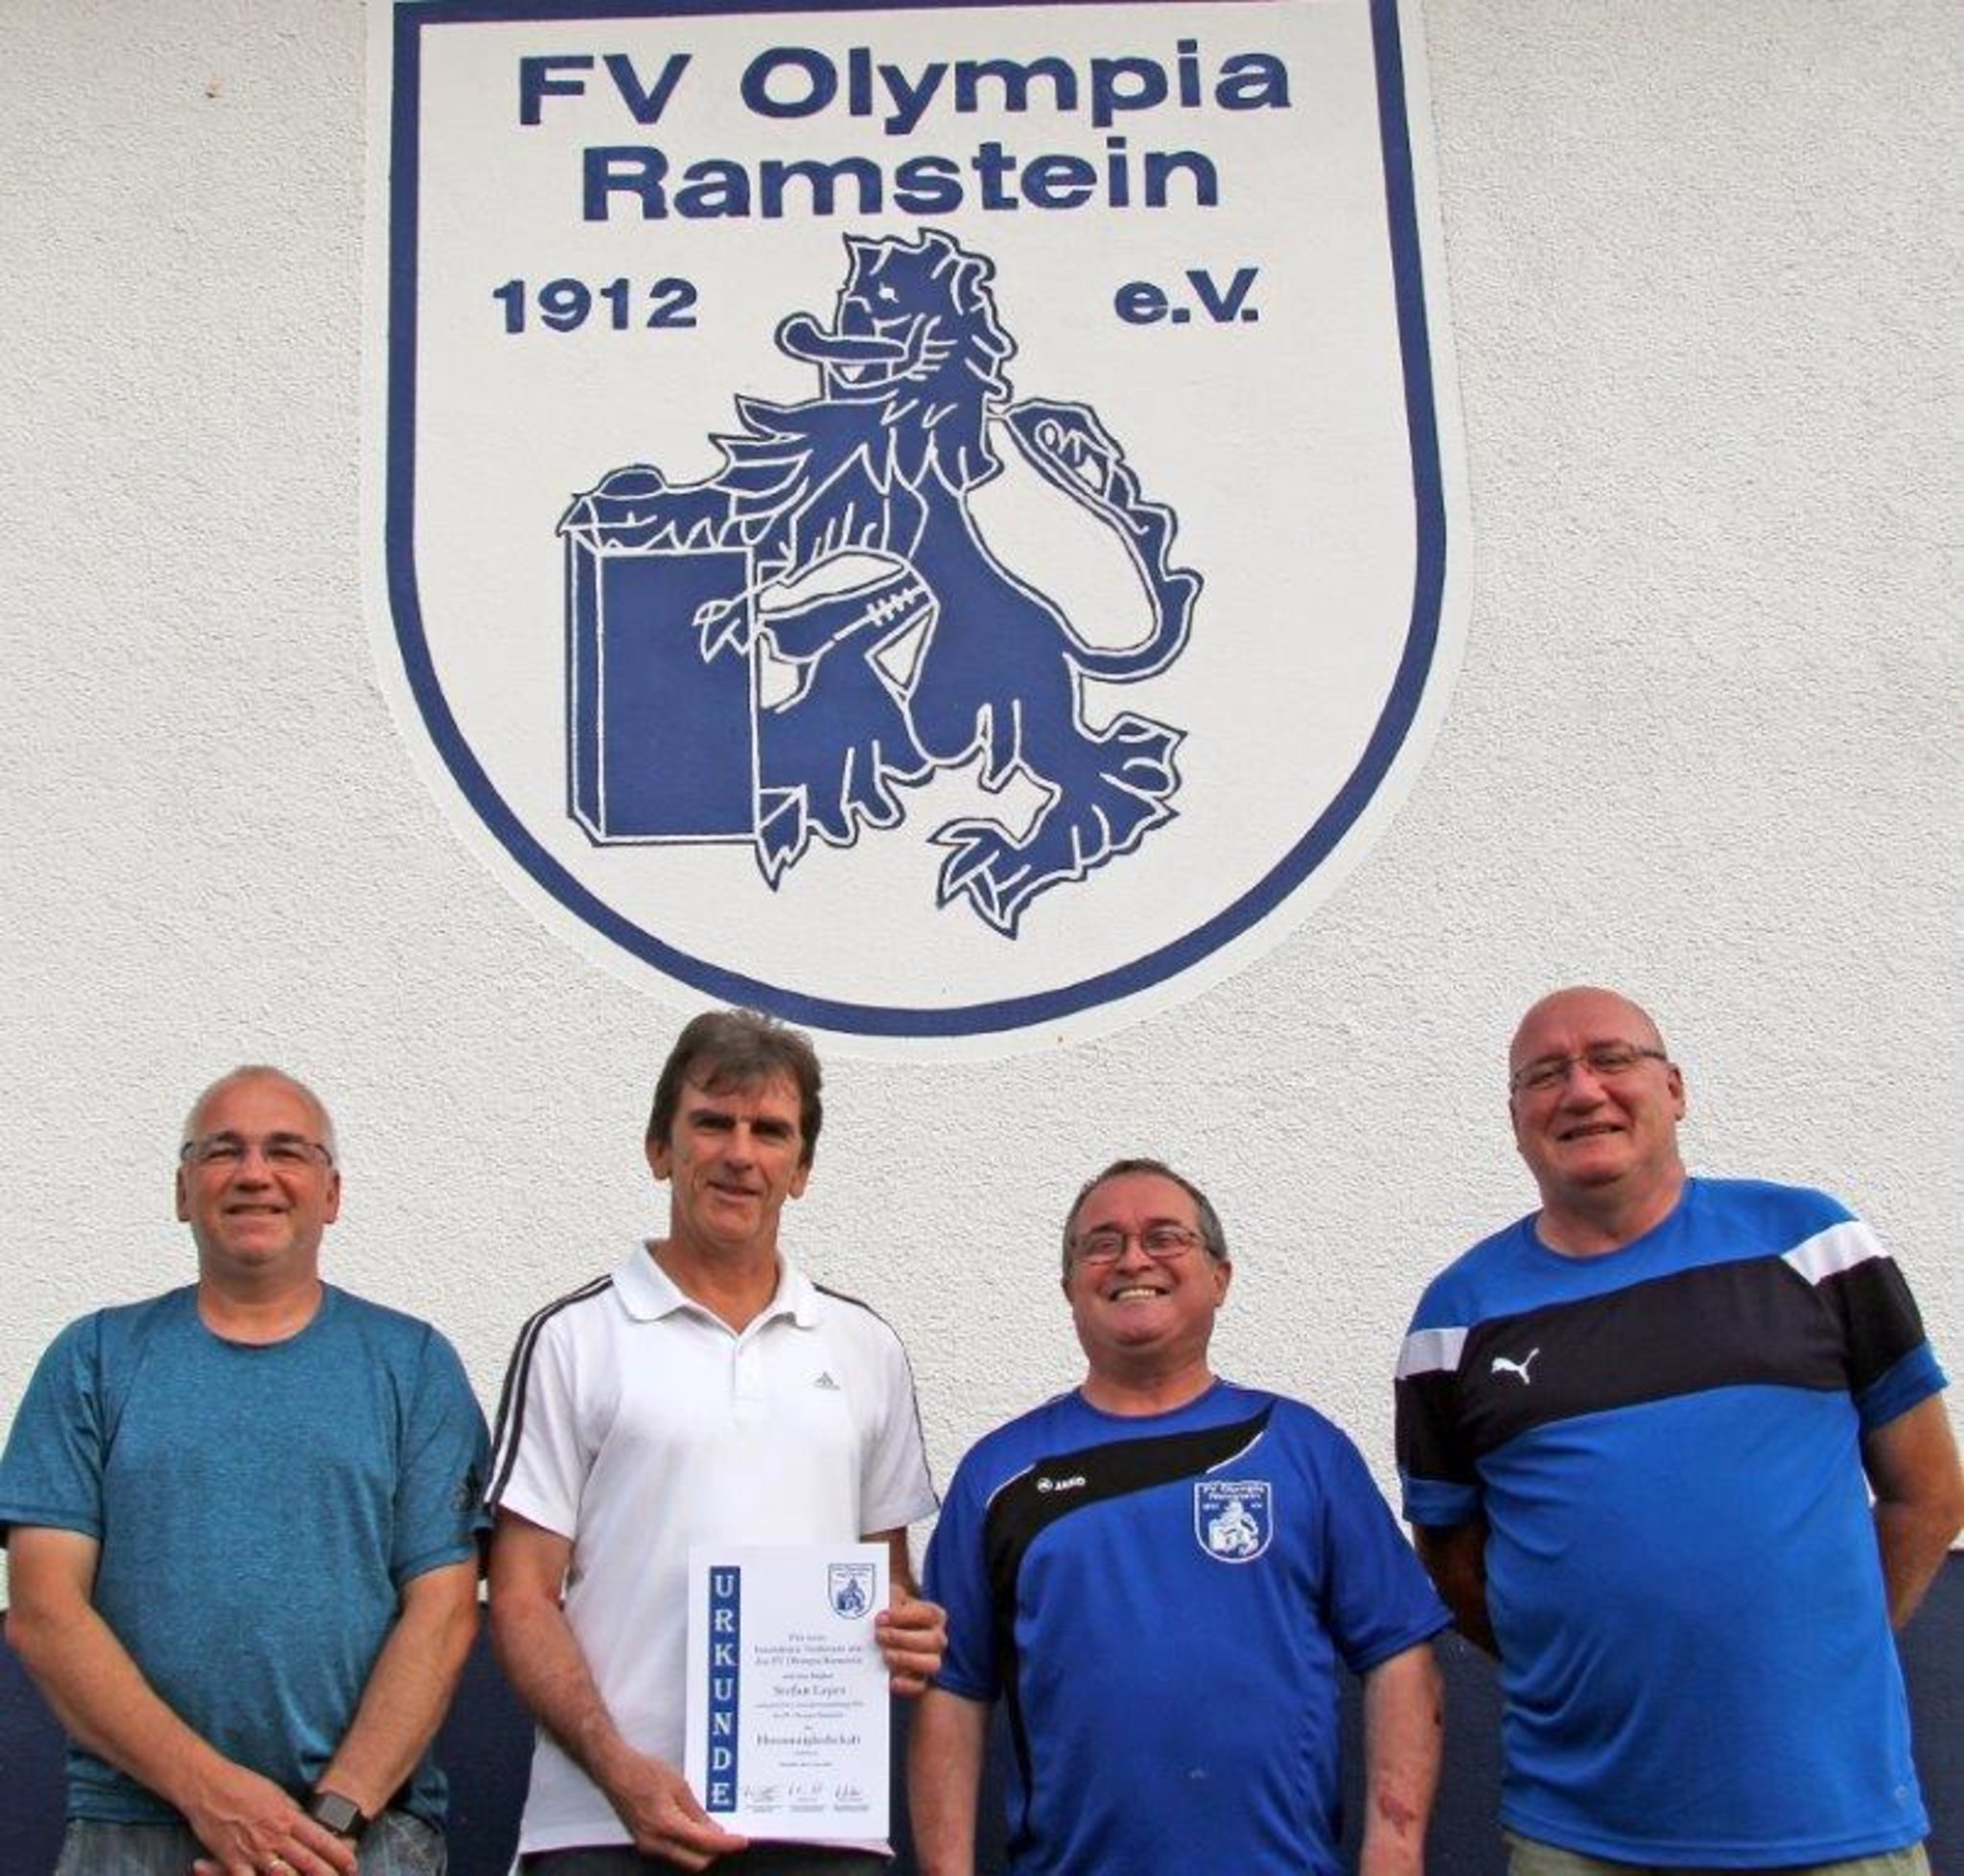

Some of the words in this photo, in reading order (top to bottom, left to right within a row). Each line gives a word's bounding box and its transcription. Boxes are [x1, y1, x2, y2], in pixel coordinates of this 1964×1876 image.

[518, 53, 692, 126] FV
[739, 39, 1292, 136] Olympia
[582, 136, 1219, 222] Ramstein
[492, 277, 698, 335] 1912
[1113, 267, 1259, 325] e.V.
[712, 1574, 736, 1806] URKUNDE
